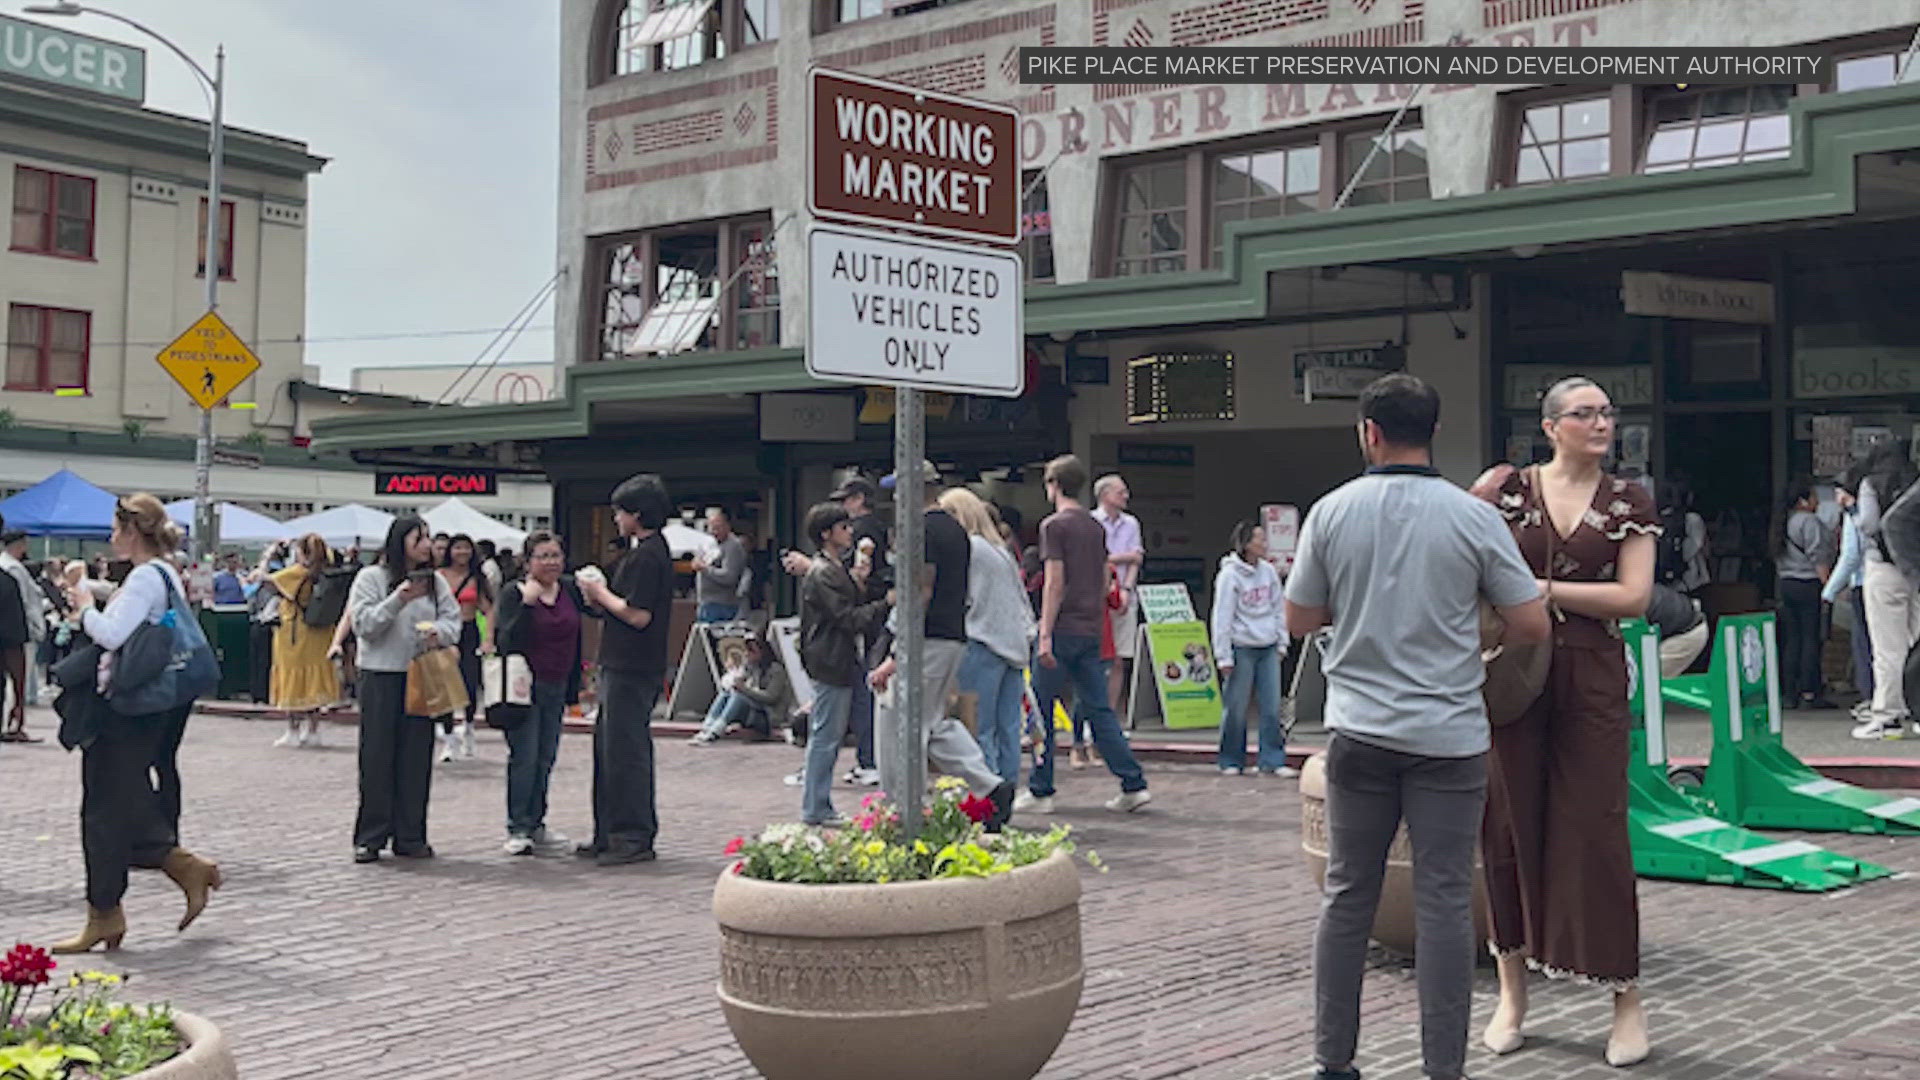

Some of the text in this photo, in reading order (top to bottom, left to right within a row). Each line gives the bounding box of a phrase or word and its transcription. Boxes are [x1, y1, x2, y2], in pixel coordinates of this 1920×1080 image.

[0, 25, 127, 90] UCER
[835, 96, 995, 167] WORKING
[1021, 85, 1231, 161] ORNER
[843, 152, 992, 216] MARKET
[832, 249, 1000, 299] AUTHORIZED
[852, 292, 981, 336] VEHICLES
[170, 350, 247, 364] PEDESTRIANS
[884, 336, 950, 373] ONLY
[1798, 356, 1912, 392] books
[385, 474, 487, 493] ADITI CHAI
